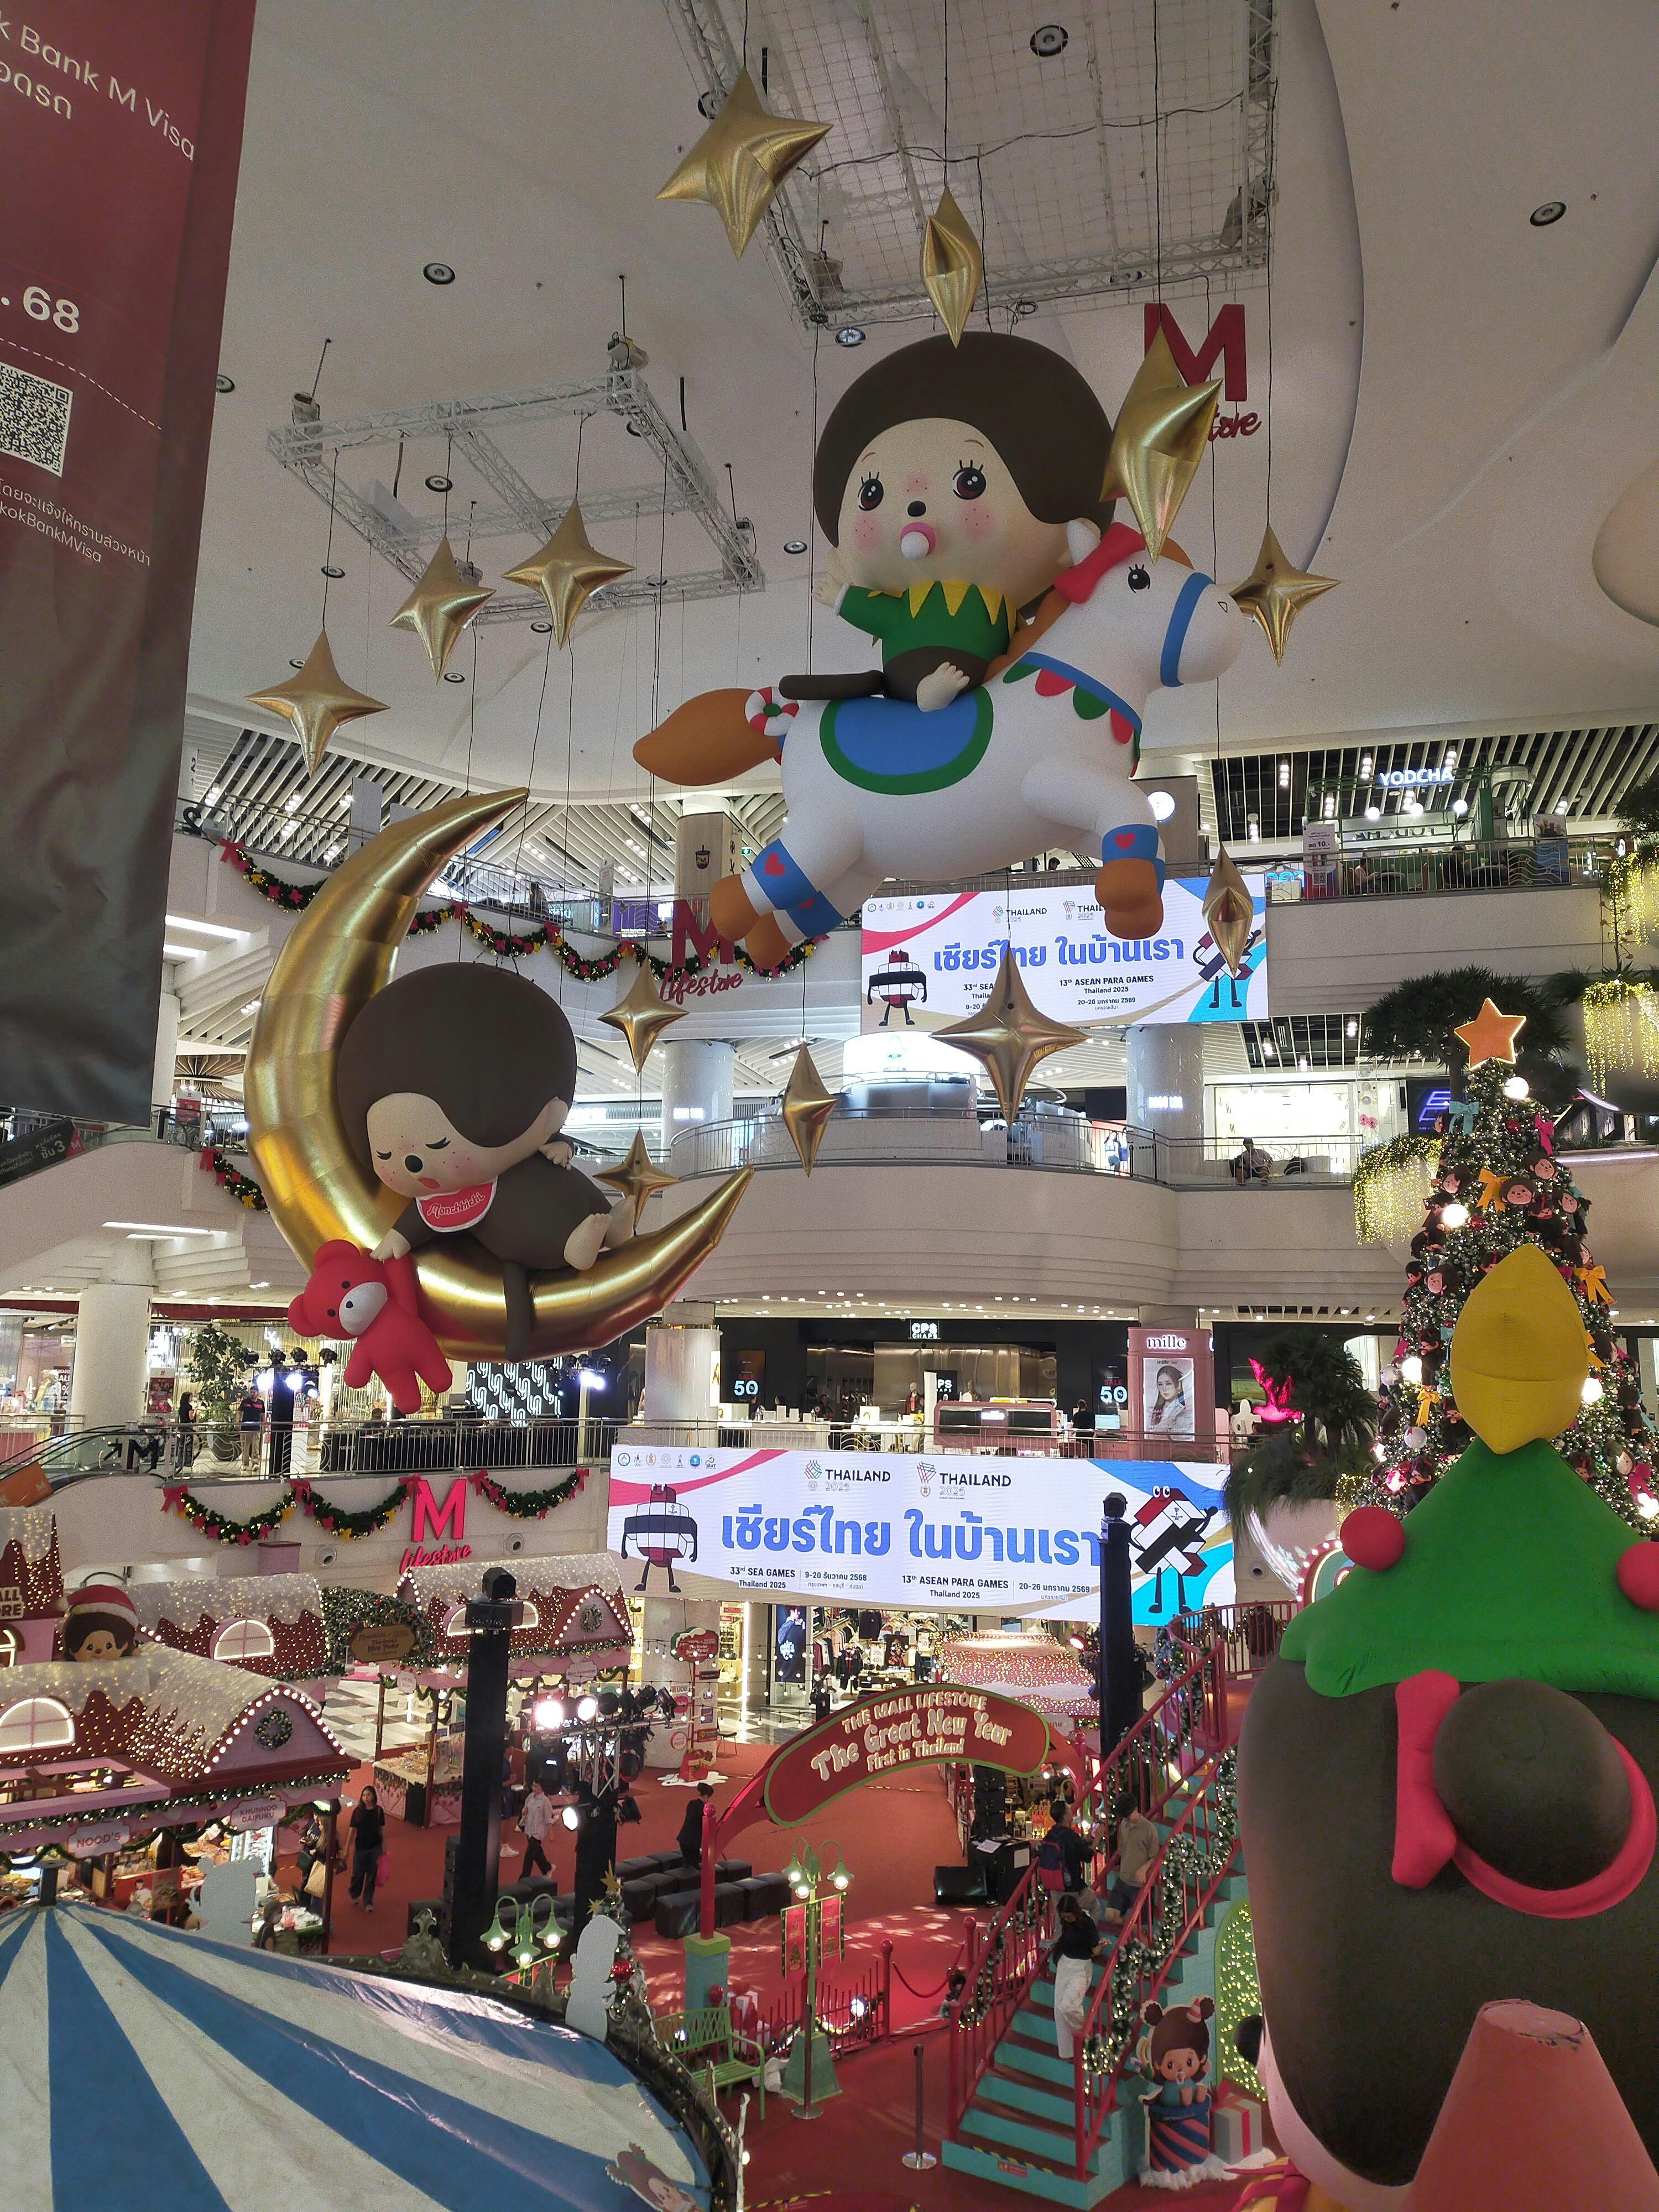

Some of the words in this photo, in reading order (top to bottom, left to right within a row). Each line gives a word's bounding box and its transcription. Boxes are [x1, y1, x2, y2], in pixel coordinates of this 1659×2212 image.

[20, 25, 100, 92] Bank
[108, 75, 136, 112] M
[145, 97, 195, 161] Visa
[23, 286, 79, 333] 68
[1144, 303, 1247, 401] M
[1379, 766, 1454, 786] YODCHA
[1006, 908, 1047, 916] THAILAND
[1077, 904, 1106, 912] THAIL
[672, 899, 734, 968] M
[1055, 934, 1184, 965] ในบ้านเรา
[1075, 977, 1101, 986] ASEAN
[55, 1140, 65, 1152] 3
[427, 1192, 485, 1219] Monchhichi
[911, 1323, 937, 1334] CPS
[1147, 1335, 1186, 1349] mille
[825, 1469, 891, 1482] THAILAND
[939, 1473, 1011, 1487] THAILAND
[825, 1481, 850, 1492] 2025
[939, 1486, 966, 1496] 2025
[411, 1479, 467, 1542] M
[722, 1504, 891, 1556] เชียร์ไทย
[904, 1509, 1100, 1567] ในบ้านเรา
[730, 1567, 745, 1575] 33rd
[748, 1568, 764, 1576] SEA
[766, 1568, 795, 1578] GAMES
[823, 1572, 848, 1580] ธันวาคม
[902, 1575, 917, 1583] 13th
[919, 1576, 948, 1585] ASEAN
[951, 1578, 974, 1587] PARA
[977, 1579, 1009, 1589] GAMES
[930, 1589, 961, 1598] Thailand
[962, 1590, 980, 1599] 2025
[842, 1709, 872, 1734] THE
[874, 1695, 913, 1720] MALL
[916, 1692, 988, 1710] LIFESTORE
[811, 1742, 859, 1781] The
[864, 1713, 922, 1754] Great
[927, 1708, 968, 1736] New
[974, 1710, 1012, 1746] Year
[867, 1749, 896, 1772] First
[898, 1744, 911, 1761] in
[912, 1738, 965, 1757] Thailand
[239, 1804, 276, 1815] KHUNNOO
[242, 1812, 274, 1823] DAIFUKU
[77, 1832, 120, 1848] NOOD'S
